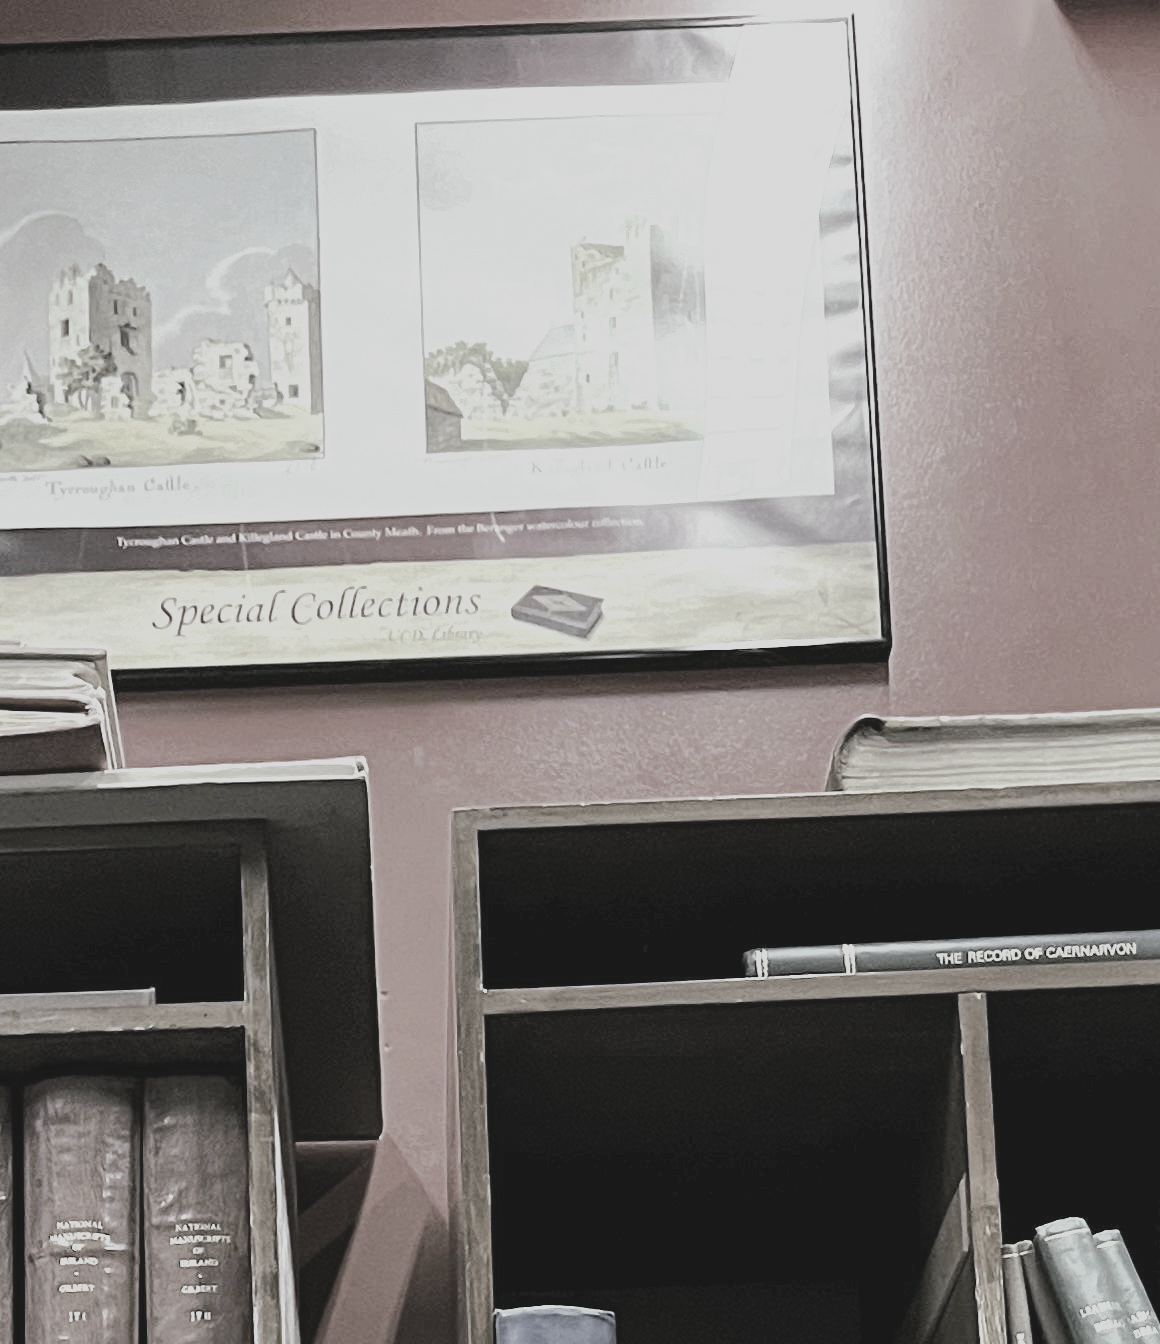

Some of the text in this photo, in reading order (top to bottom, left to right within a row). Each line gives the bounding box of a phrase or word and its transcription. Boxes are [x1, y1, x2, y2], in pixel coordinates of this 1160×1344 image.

[216, 533, 236, 545] and
[330, 529, 341, 539] in
[343, 527, 381, 541] County
[427, 524, 455, 536] From
[458, 523, 475, 534] the
[152, 585, 482, 637] Special Collections
[431, 624, 483, 644] Library
[936, 941, 1137, 965] THE RECORD OF CAERNARVON
[56, 1220, 104, 1231] NATIONAL
[175, 1222, 222, 1232] NATIONAL
[169, 1234, 232, 1246] MANUSCRIPTS
